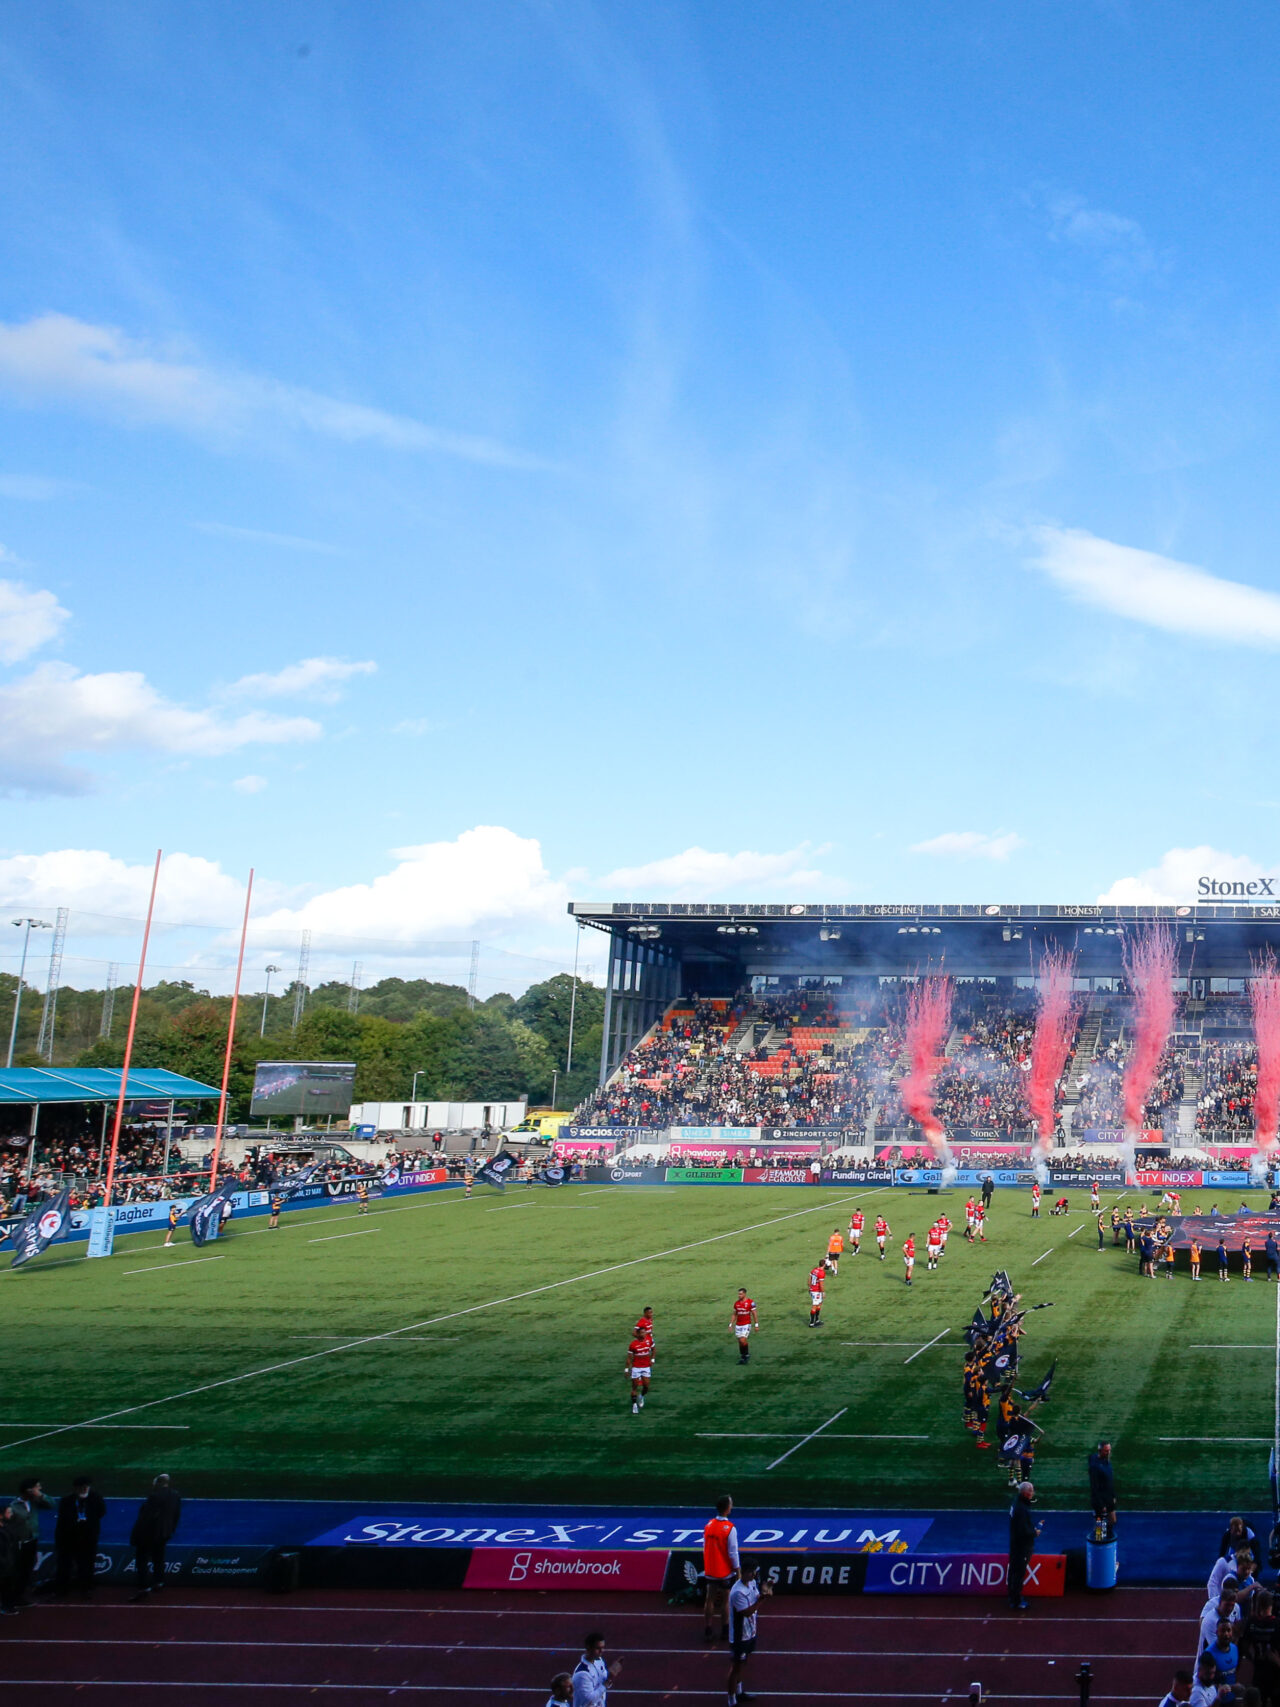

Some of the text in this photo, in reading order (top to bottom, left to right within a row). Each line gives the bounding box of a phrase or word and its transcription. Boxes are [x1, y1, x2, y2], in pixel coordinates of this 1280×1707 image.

[1198, 877, 1276, 896] StoneX
[874, 906, 917, 914] DISCIPLINE
[1064, 906, 1103, 915] HONESTY
[414, 1172, 436, 1184] INDEX
[685, 1171, 723, 1179] GILBERT
[832, 1171, 891, 1181] Funding Circle
[1135, 1173, 1194, 1183] CITY INDEX
[344, 1522, 594, 1544] StoneX
[533, 1558, 622, 1576] shawbrook
[768, 1566, 851, 1585] STORE
[890, 1562, 1040, 1587] CITY INDX
